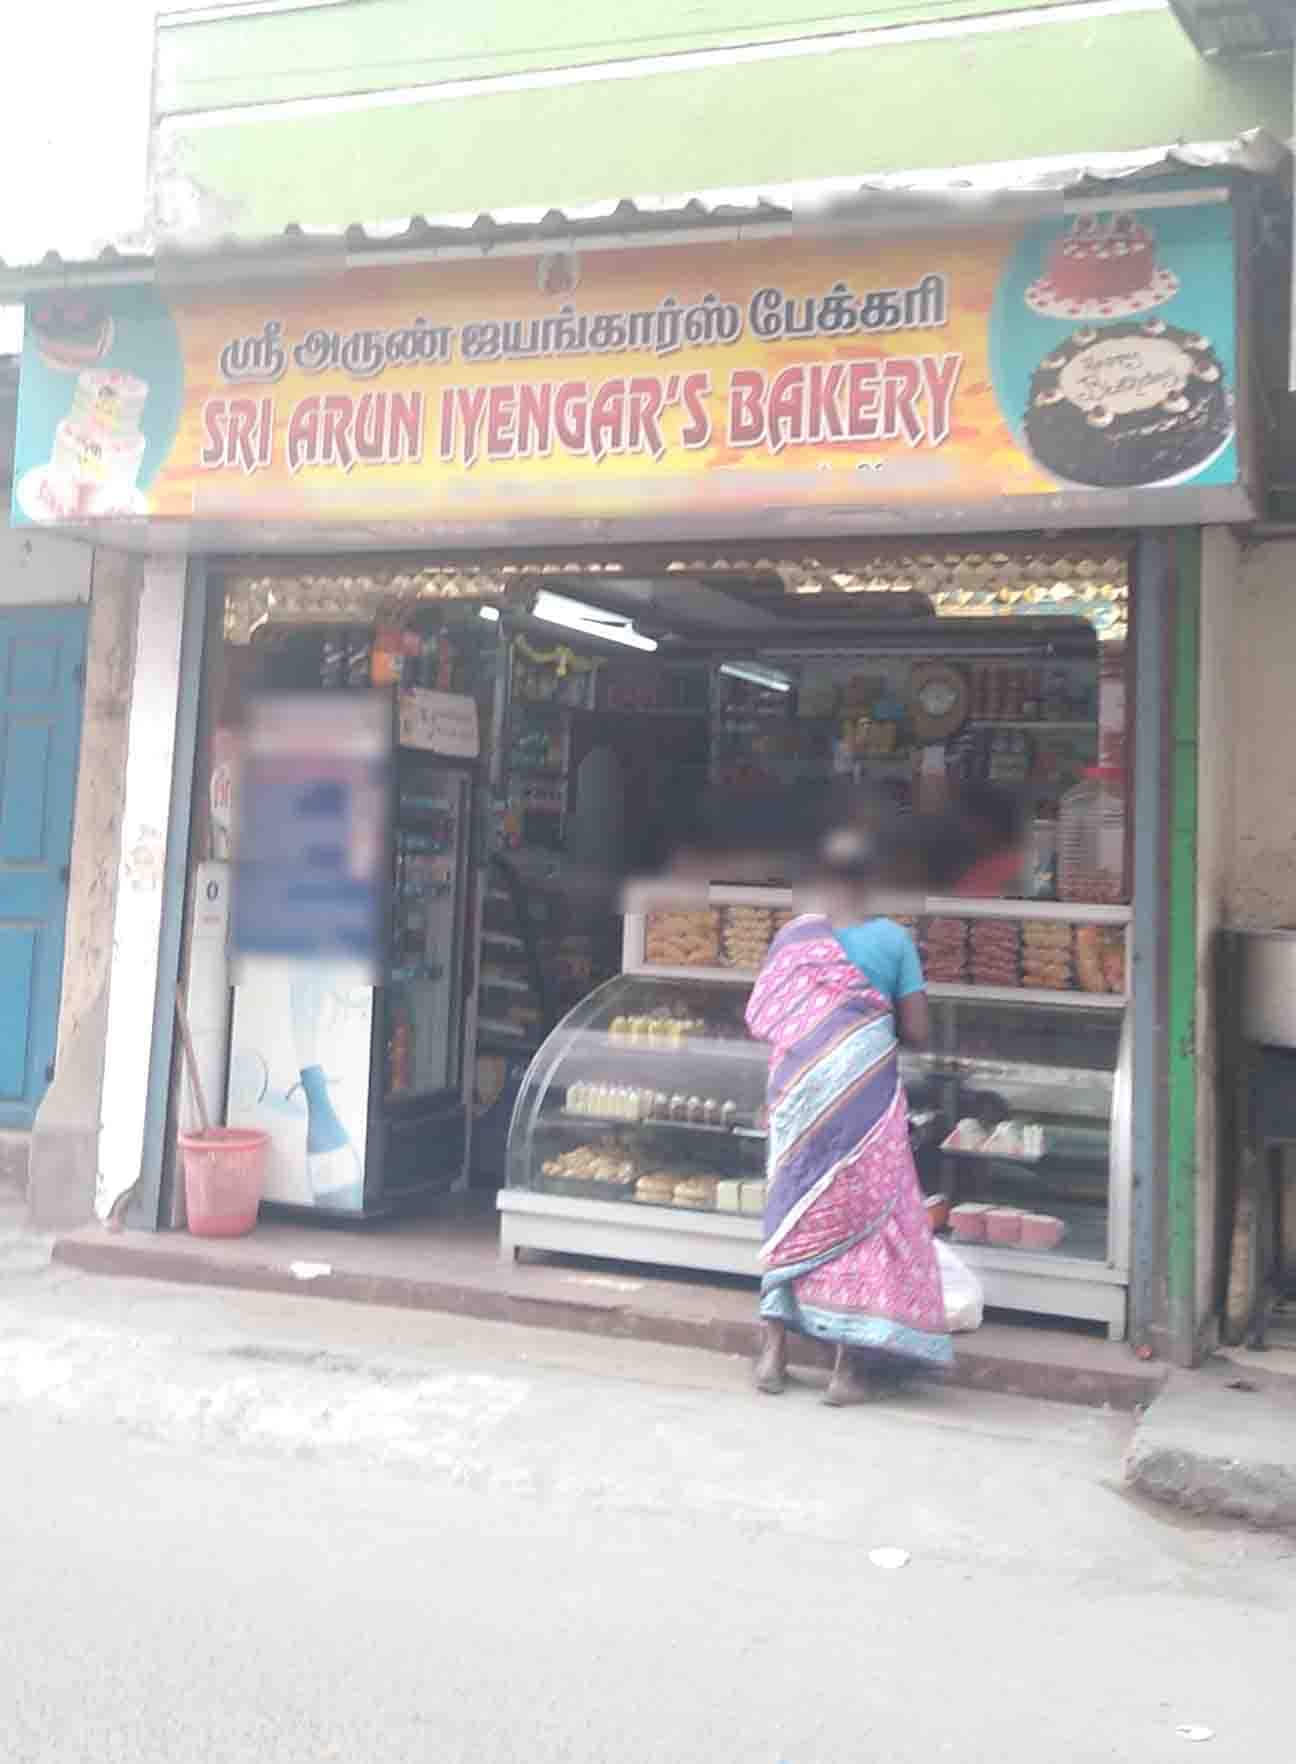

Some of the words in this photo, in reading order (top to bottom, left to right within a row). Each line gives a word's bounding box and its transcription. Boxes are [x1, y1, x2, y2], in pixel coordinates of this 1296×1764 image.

[294, 317, 453, 377] அருண்
[749, 273, 946, 340] பேக்கரி
[201, 394, 274, 474] SRI
[288, 389, 424, 475] ARUN
[438, 374, 712, 465] IYENGAR'S
[727, 352, 962, 453] BAKERY
